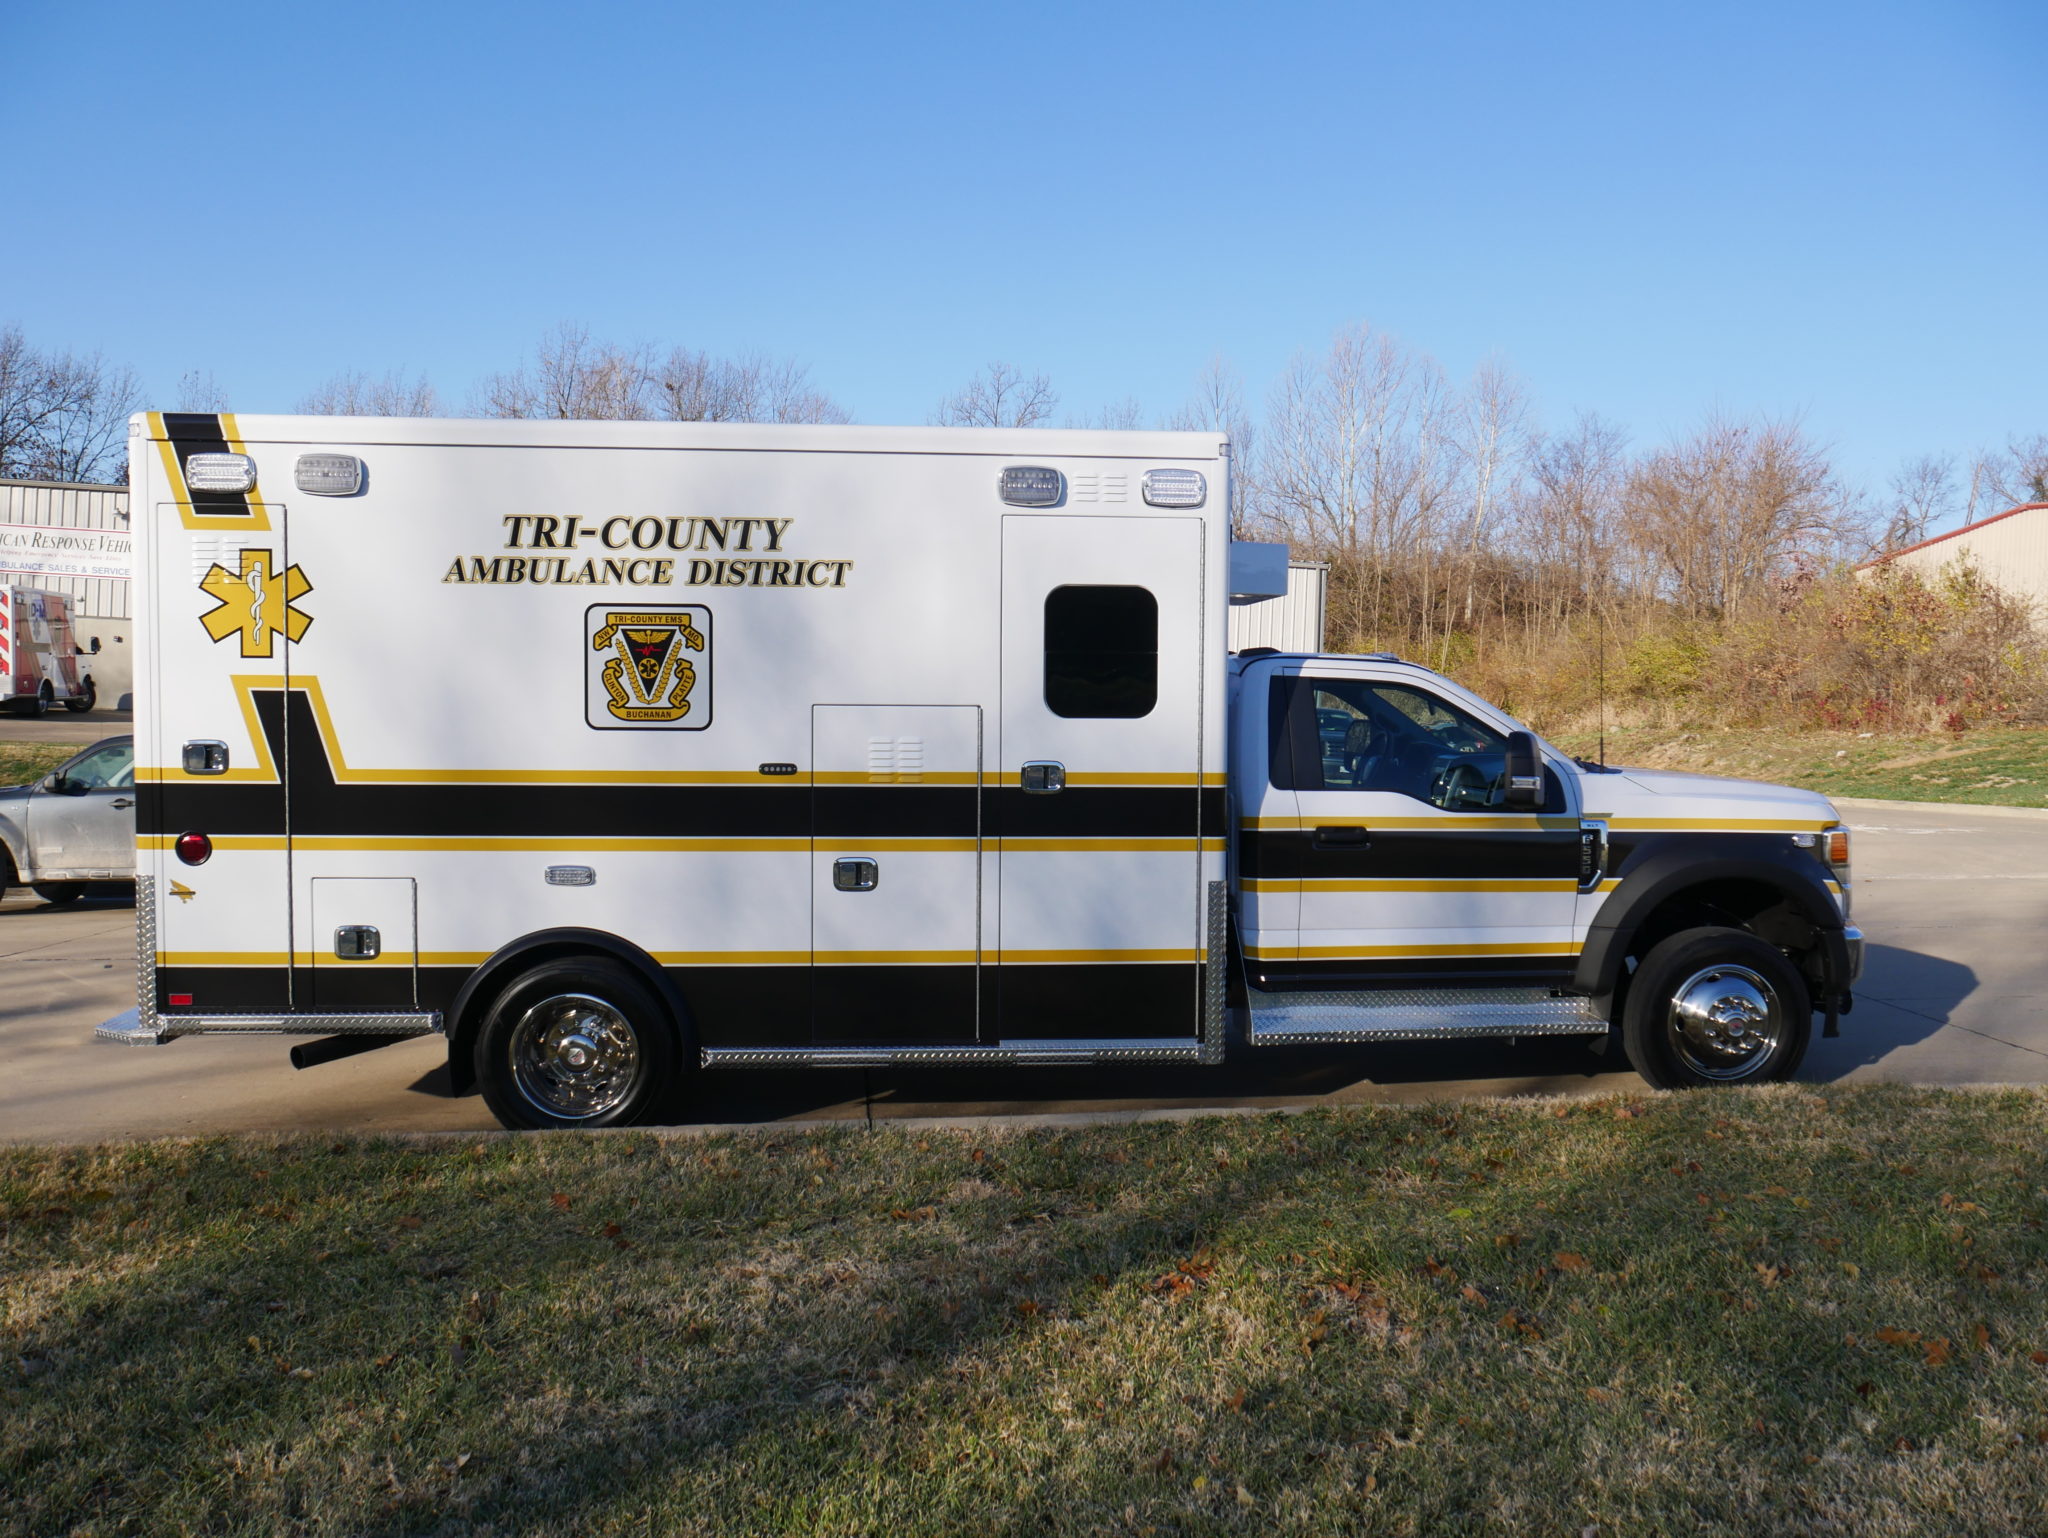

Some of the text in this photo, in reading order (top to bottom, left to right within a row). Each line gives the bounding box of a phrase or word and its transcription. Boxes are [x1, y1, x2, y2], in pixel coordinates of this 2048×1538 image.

[502, 514, 794, 552] TRI-COUNTY
[31, 532, 97, 551] RESPONSE
[0, 560, 45, 571] BULANCE
[47, 563, 77, 573] SALES
[441, 556, 854, 588] AMBULANCE DISTRICT
[614, 615, 683, 624] TRI-COUNTY EMS
[598, 629, 610, 640] NW
[686, 630, 699, 641] MO
[604, 673, 625, 703] CLINTON
[672, 674, 693, 701] PLATTE
[626, 711, 672, 719] BUCHANAN
